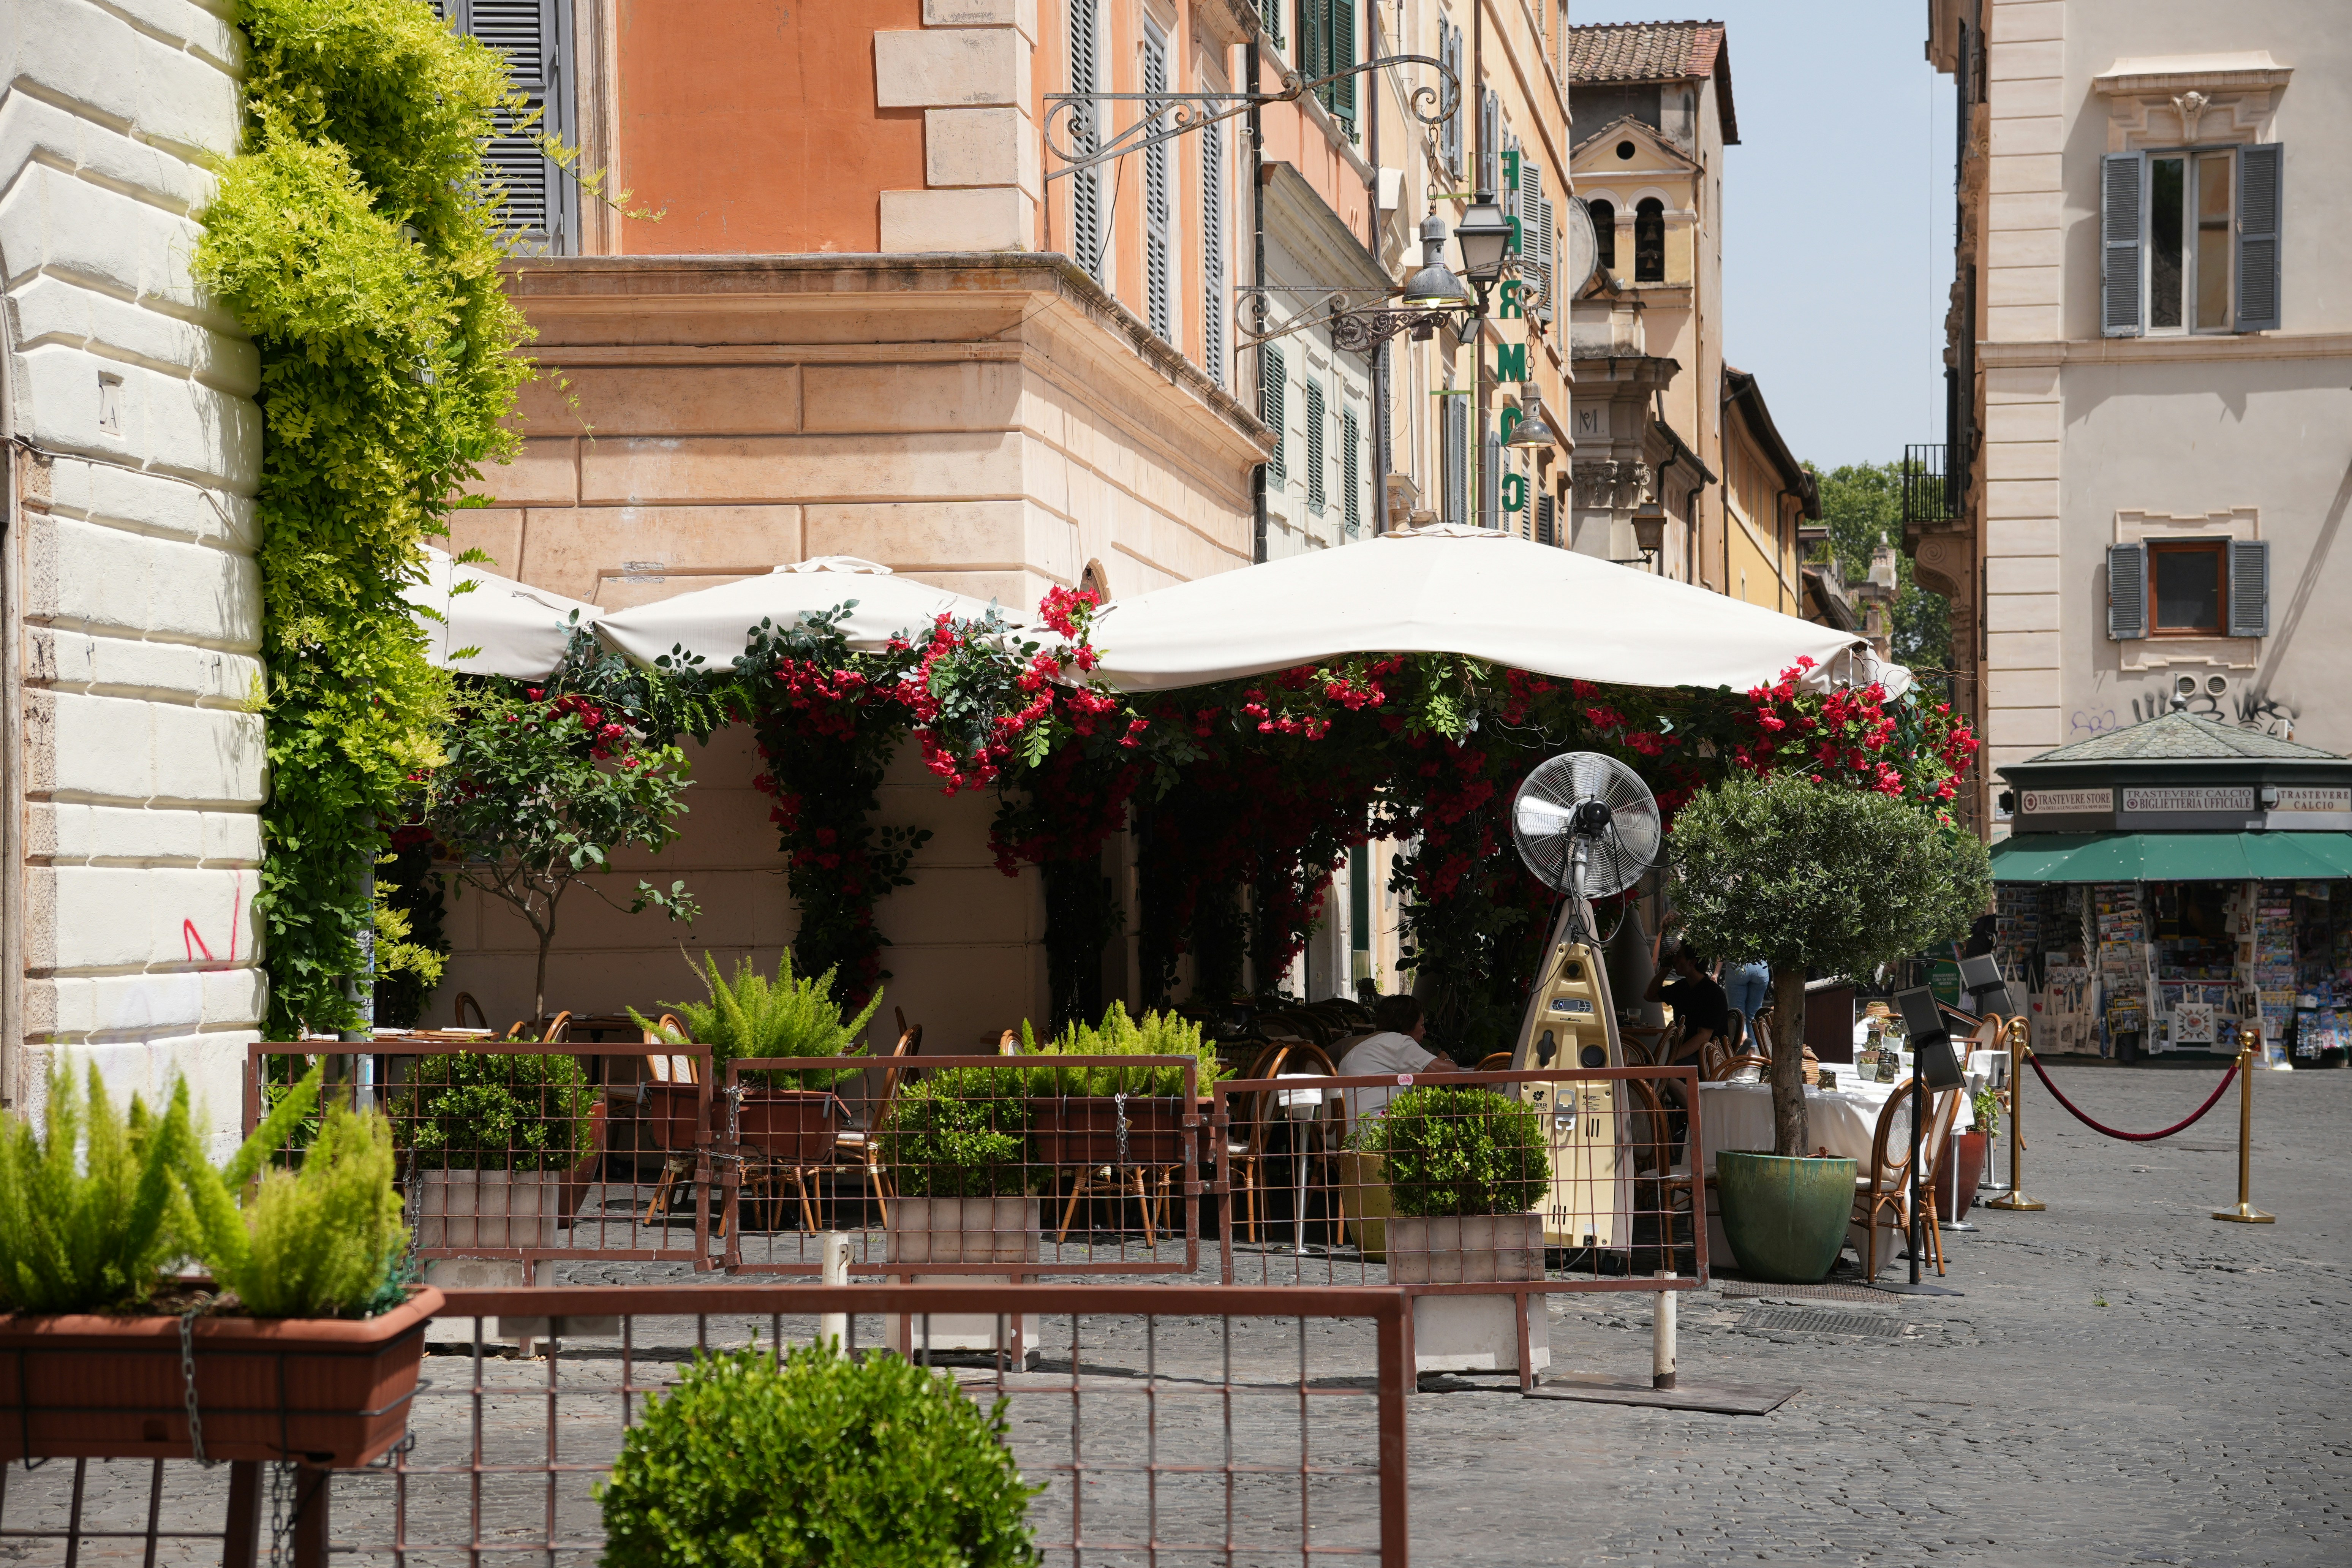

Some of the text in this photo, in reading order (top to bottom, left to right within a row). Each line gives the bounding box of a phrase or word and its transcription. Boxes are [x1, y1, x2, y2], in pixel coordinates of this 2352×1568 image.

[2038, 793, 2085, 805] TRASTEVERE
[2086, 793, 2111, 804] STORE
[2281, 791, 2349, 799] TRASTEVERE
[2140, 798, 2251, 809] BIGLIETTERIA UFFICIALE
[2294, 801, 2334, 809] CALCIO
